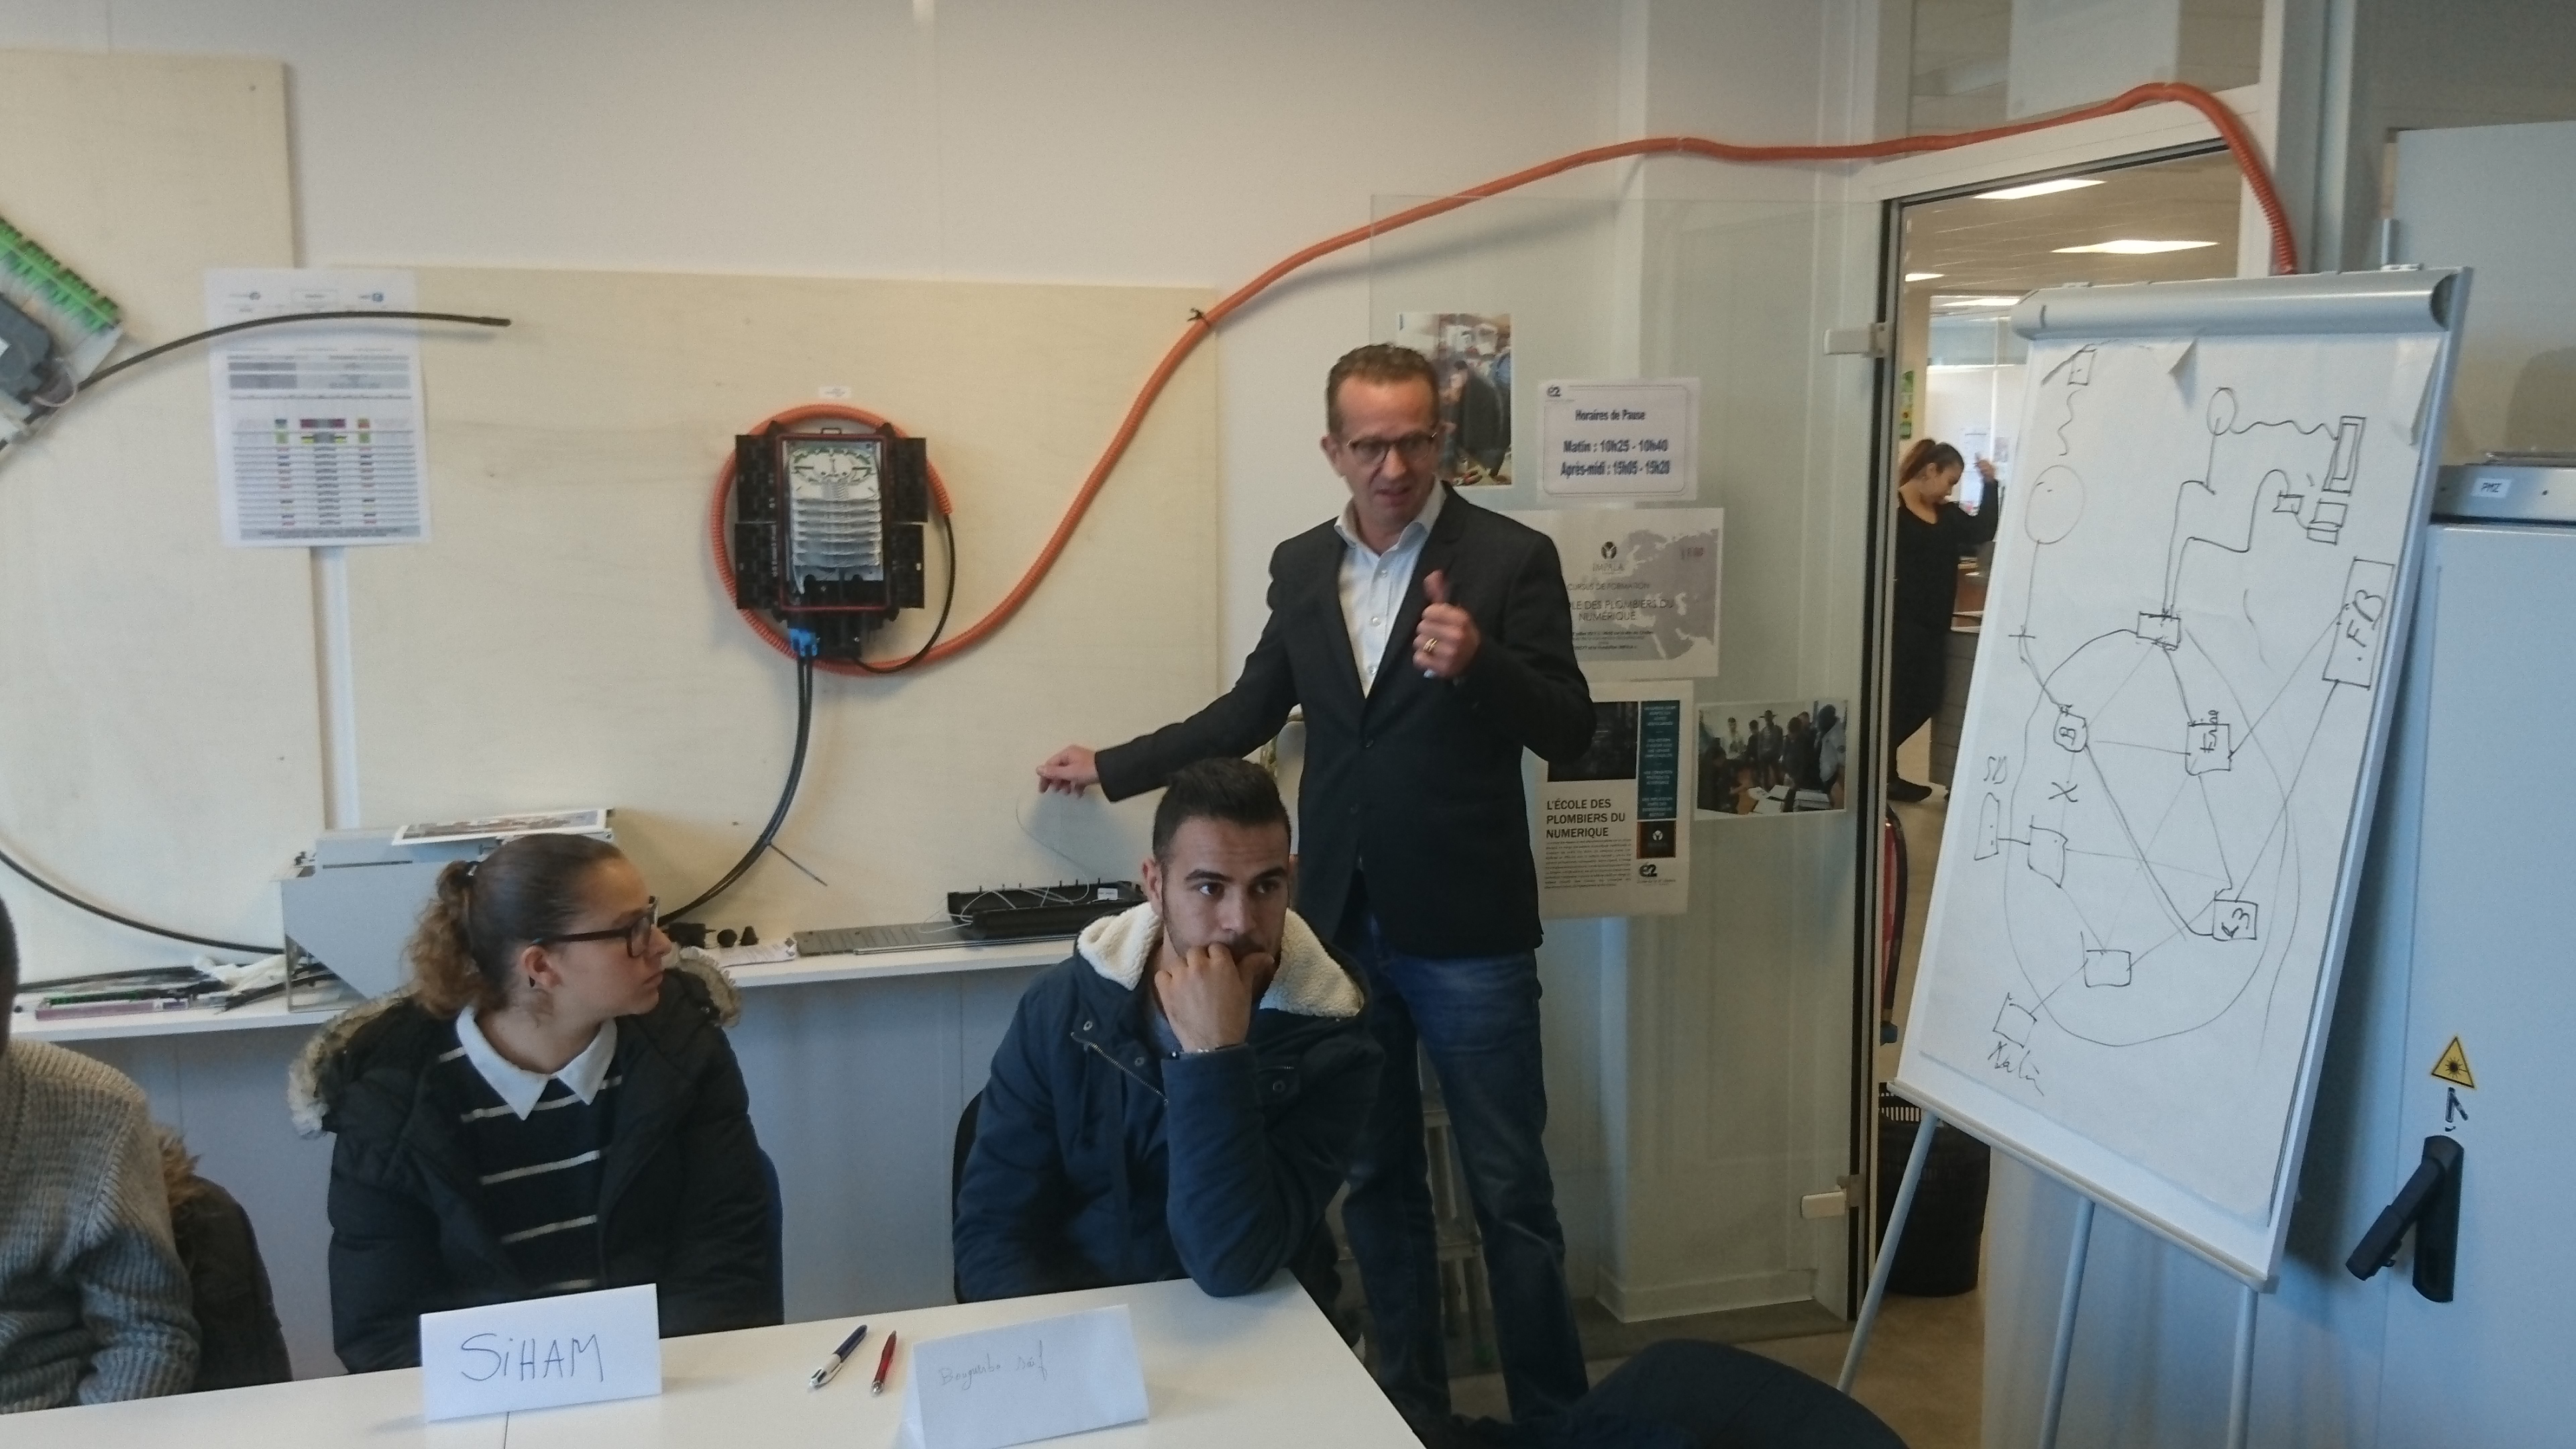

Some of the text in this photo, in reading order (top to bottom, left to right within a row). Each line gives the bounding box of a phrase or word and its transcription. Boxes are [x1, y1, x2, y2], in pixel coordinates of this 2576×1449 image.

[1575, 409, 1646, 421] Horaires de Pause
[1563, 440, 1591, 453] Matin
[1601, 439, 1629, 453] 10h25
[1639, 439, 1668, 452] 10h40
[1560, 461, 1606, 479] Après-midi
[1585, 600, 1602, 610] DES
[1605, 599, 1657, 609] PLOMBIERS
[1591, 798, 1611, 809] DES
[1546, 812, 1625, 824] PLOMBIERS DU
[1546, 827, 1609, 839] NUMERIQUE
